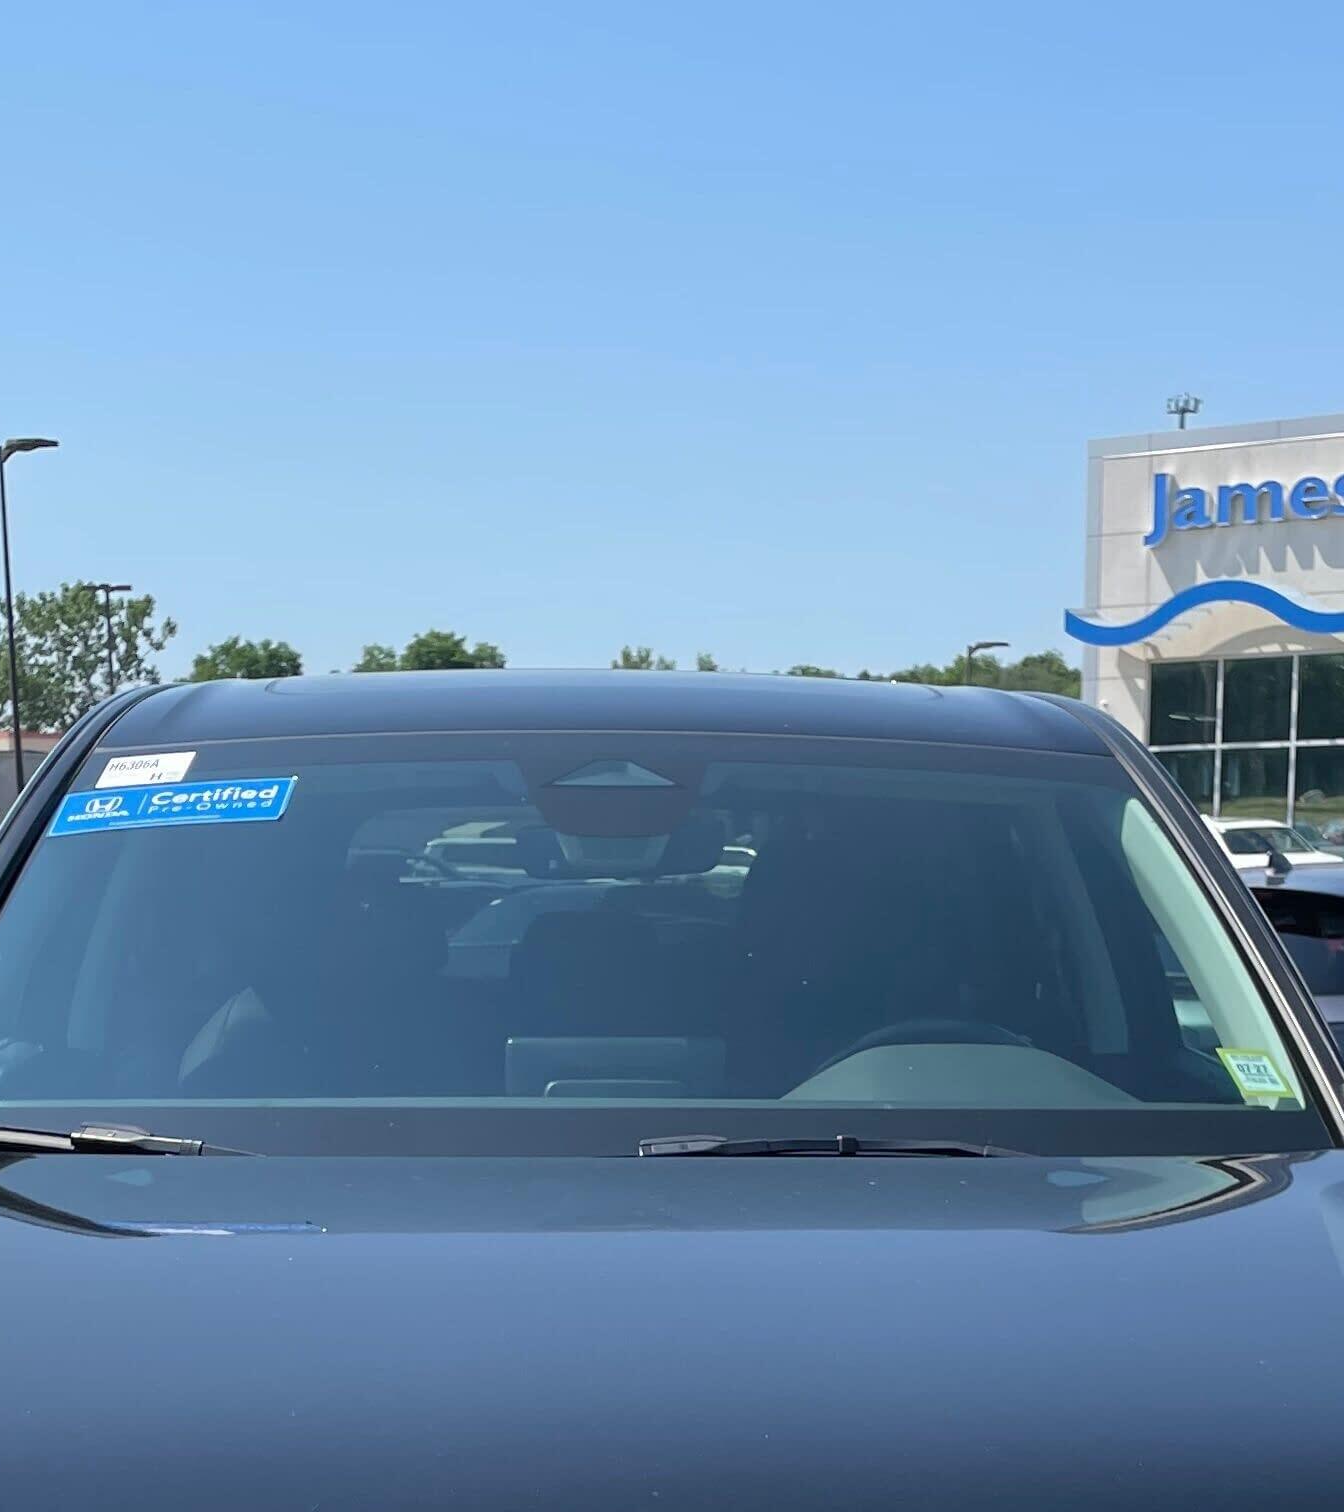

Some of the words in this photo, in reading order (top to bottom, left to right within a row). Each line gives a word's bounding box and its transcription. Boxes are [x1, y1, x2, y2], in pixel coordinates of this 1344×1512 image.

[151, 784, 279, 805] Certified
[147, 799, 273, 815] Pre-Owned
[67, 810, 130, 822] HONDA
